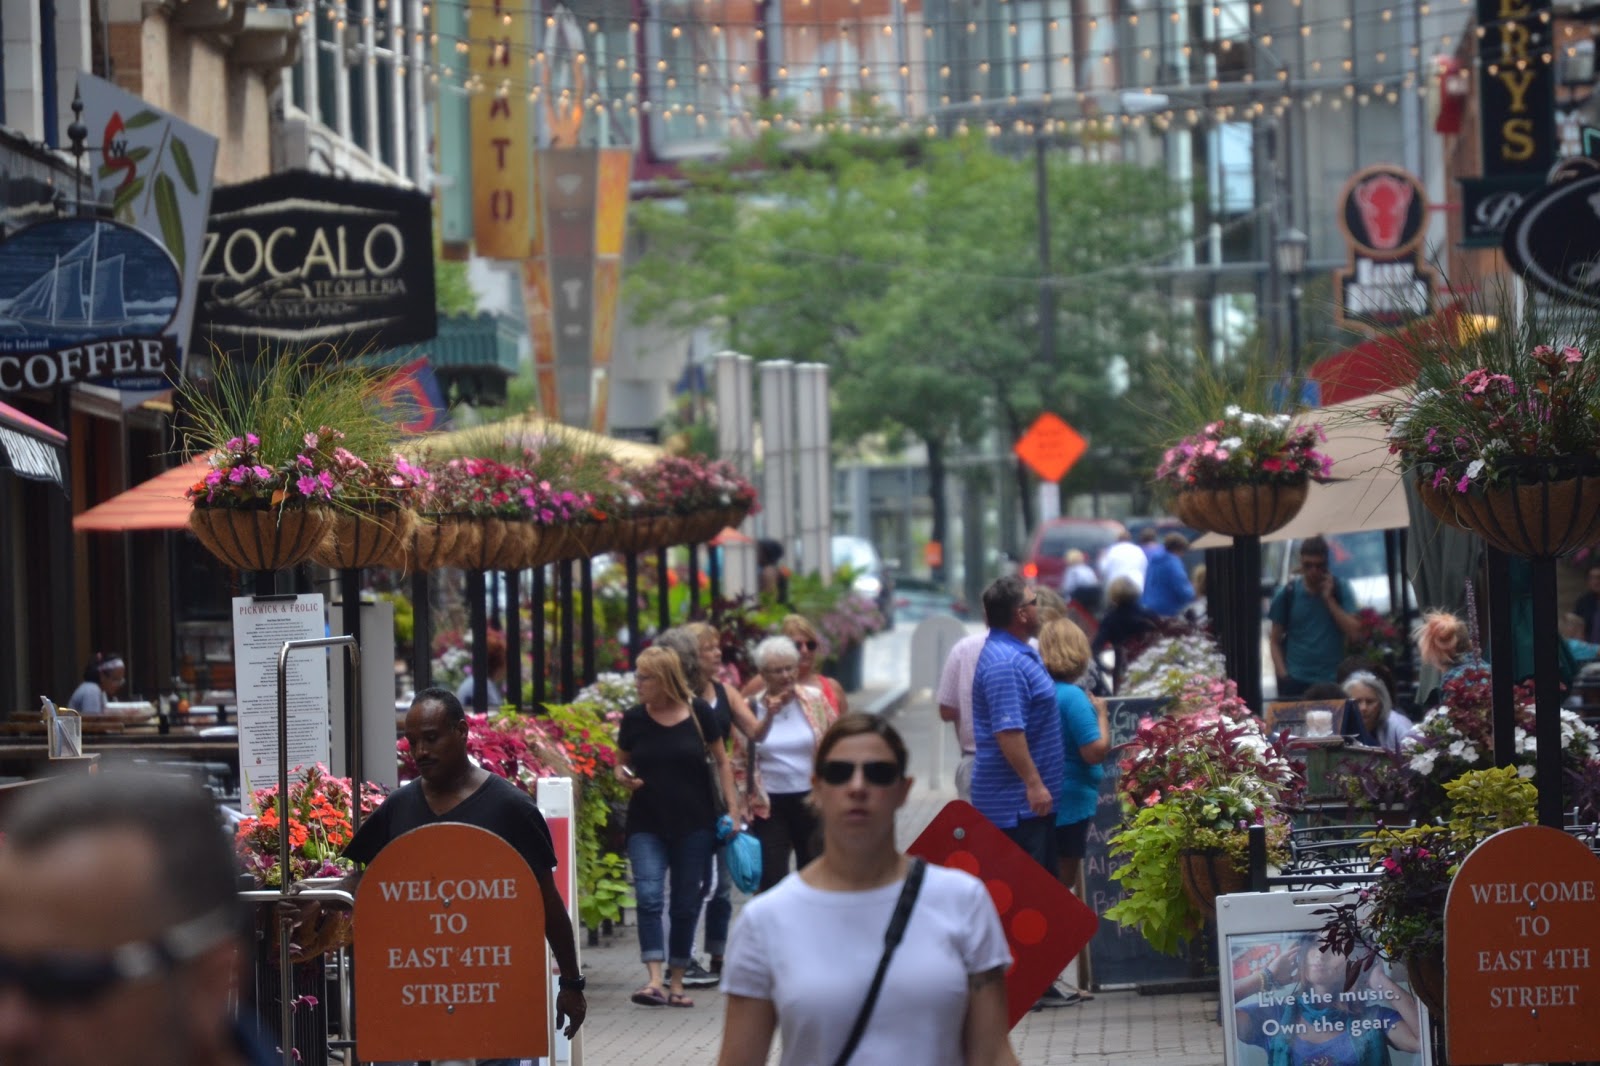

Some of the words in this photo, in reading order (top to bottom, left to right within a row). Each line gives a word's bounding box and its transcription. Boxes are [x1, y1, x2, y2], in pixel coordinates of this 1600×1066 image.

[198, 223, 404, 282] ZOCALO
[16, 338, 49, 351] Island
[0, 339, 165, 391] COFFEE
[240, 605, 278, 615] PICKWICK
[281, 605, 286, 613] &
[290, 603, 319, 613] FROLIC
[379, 879, 518, 901] WELCOME
[1470, 881, 1596, 904] WELCOME
[430, 913, 468, 934] TO
[1516, 915, 1550, 937] TO
[388, 948, 453, 969] EAST
[459, 946, 512, 967] 4TH
[1478, 950, 1537, 972] EAST
[1543, 948, 1591, 969] 4TH
[401, 982, 500, 1006] STREET
[1258, 990, 1296, 1008] Live
[1301, 988, 1333, 1005] the
[1339, 985, 1400, 1001] music.
[1490, 985, 1580, 1008] STREET
[1262, 1019, 1307, 1036] Own
[1313, 1016, 1345, 1033] the
[1351, 1017, 1396, 1037] gear.
